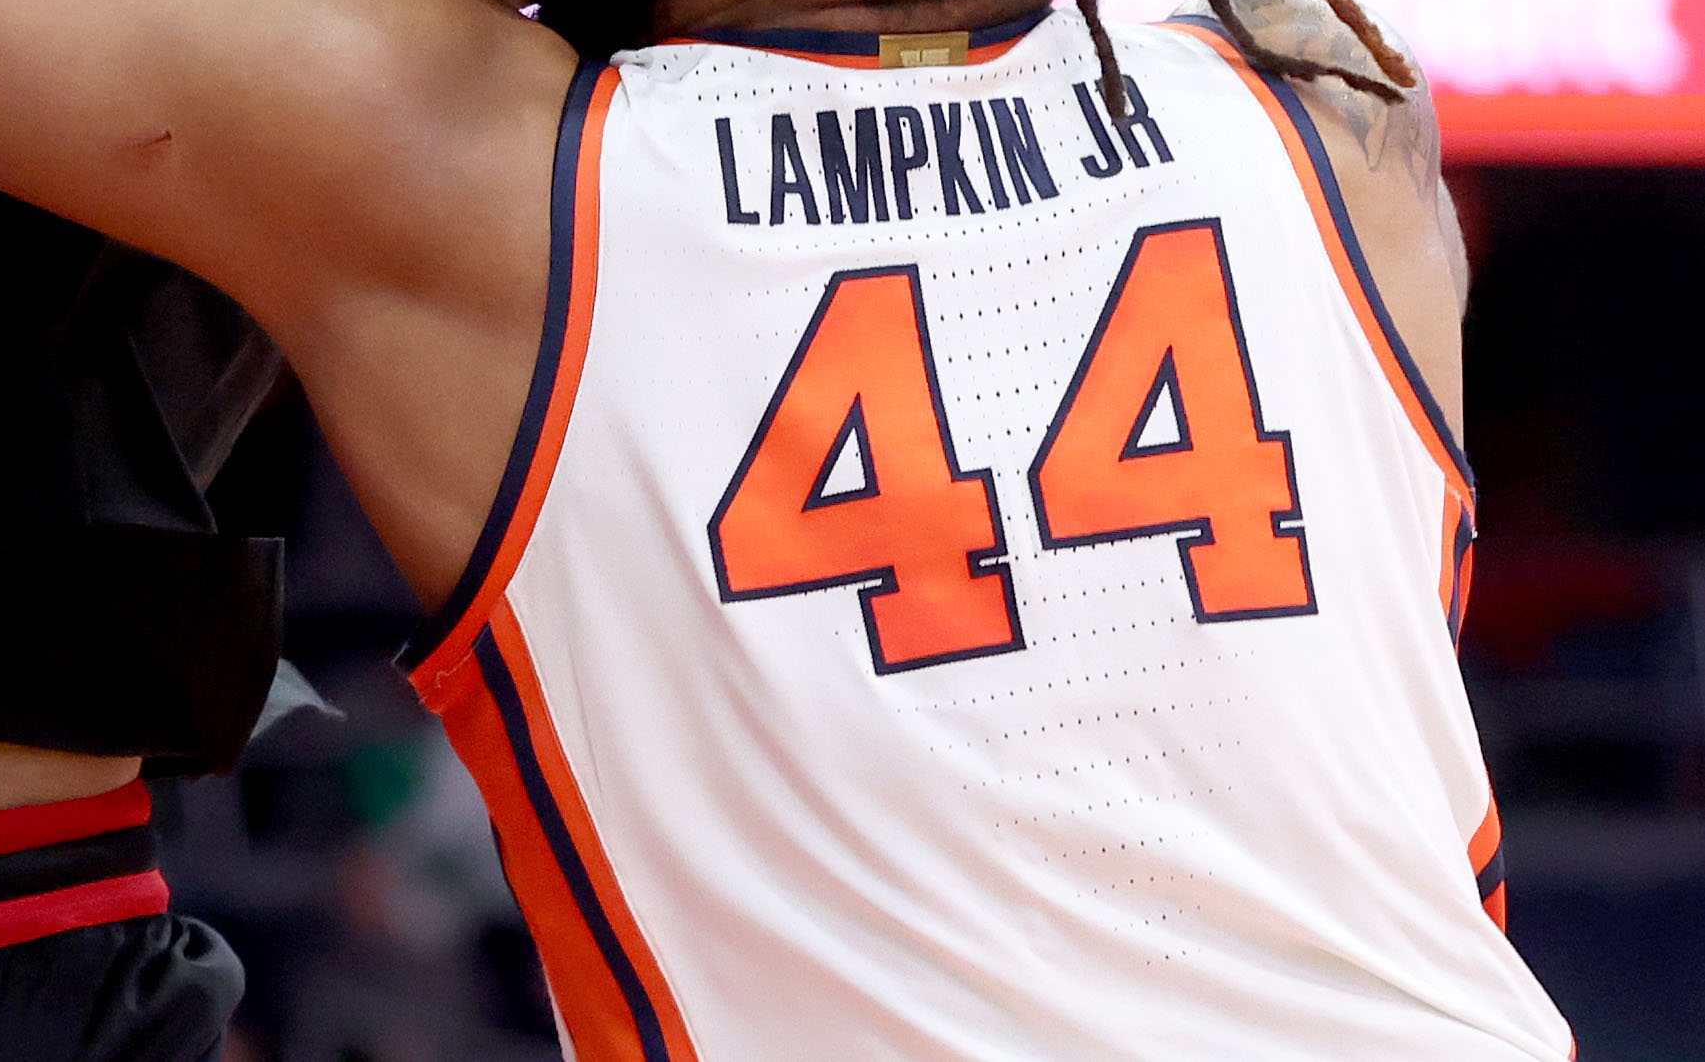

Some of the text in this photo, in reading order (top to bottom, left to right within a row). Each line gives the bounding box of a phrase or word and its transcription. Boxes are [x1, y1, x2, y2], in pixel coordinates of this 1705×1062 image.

[715, 73, 1176, 227] LAMPKIN JR
[707, 217, 1319, 676] 44
